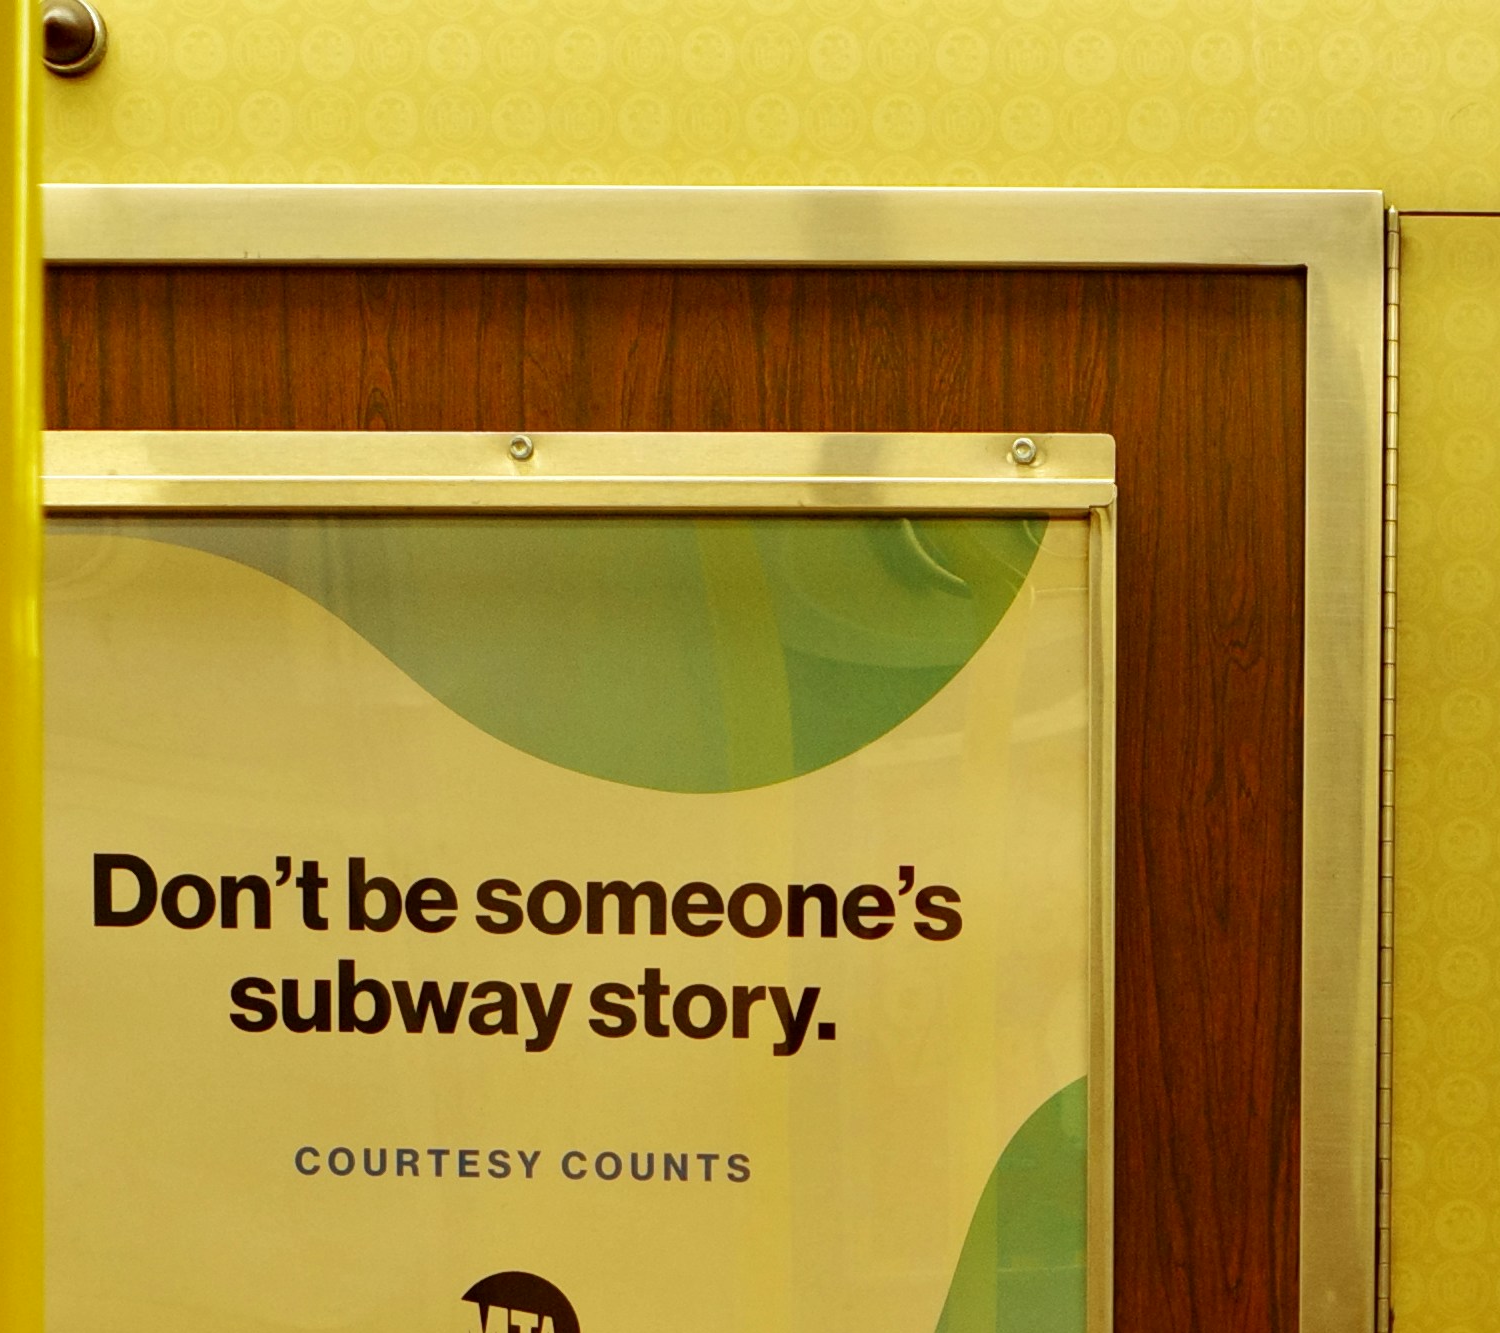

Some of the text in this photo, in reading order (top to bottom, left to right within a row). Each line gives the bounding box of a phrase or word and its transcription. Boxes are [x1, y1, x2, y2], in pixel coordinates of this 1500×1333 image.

[93, 853, 963, 942] Don't be someone's
[229, 958, 836, 1057] subway story.
[294, 1146, 751, 1183] COURTESY COUNTS
